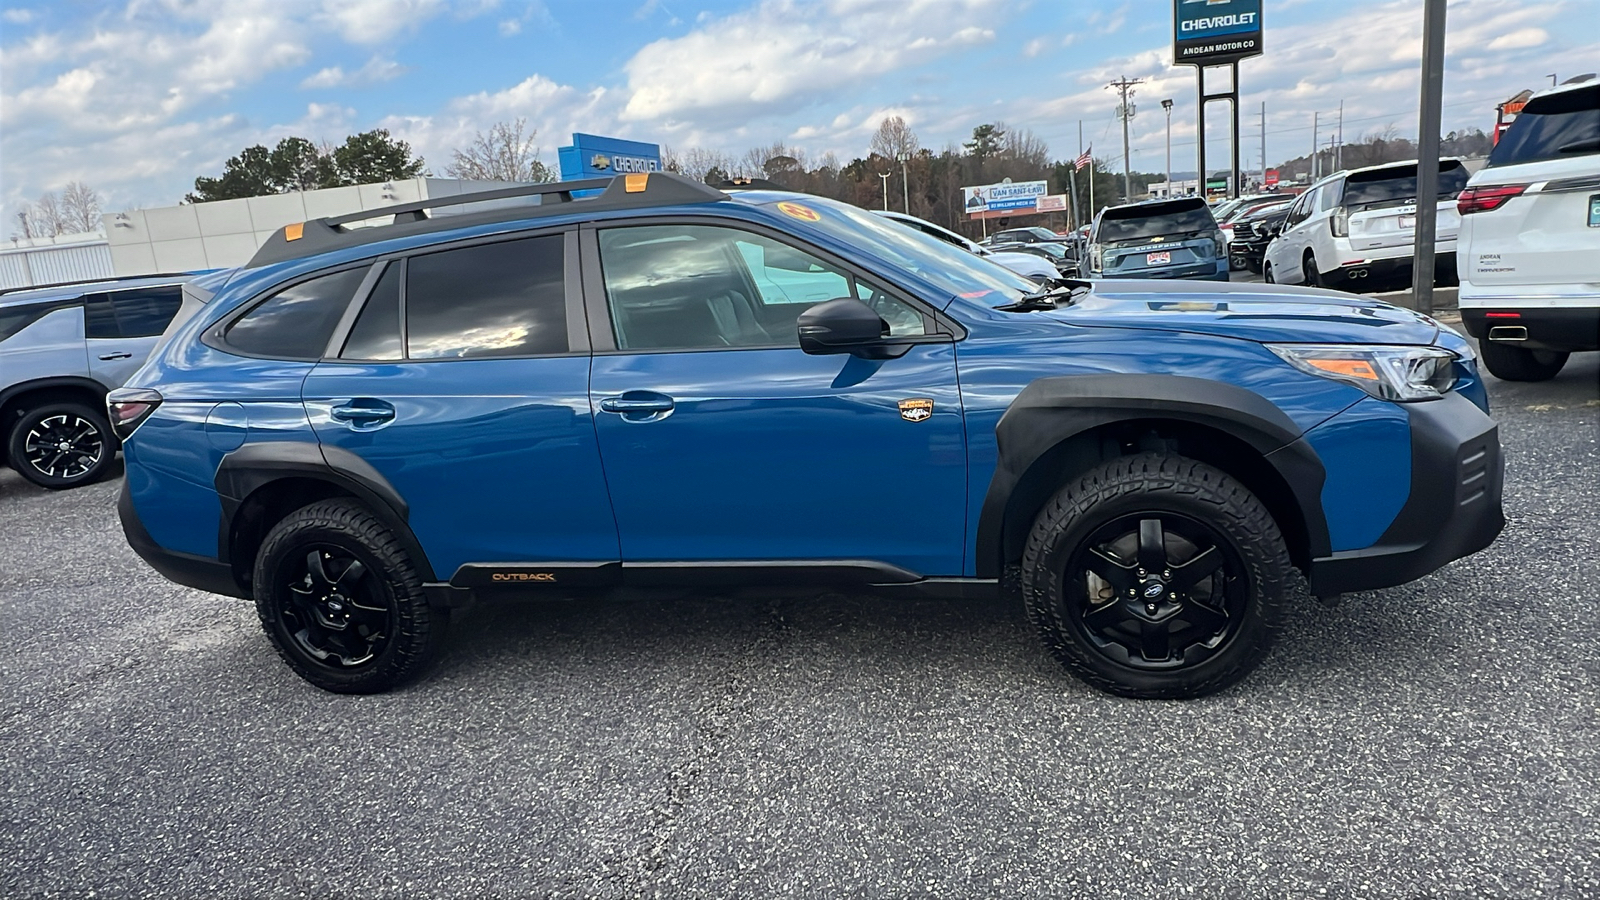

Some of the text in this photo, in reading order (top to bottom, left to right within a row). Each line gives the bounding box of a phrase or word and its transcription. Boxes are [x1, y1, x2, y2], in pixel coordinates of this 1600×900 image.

[1181, 12, 1256, 31] CHEVROLET
[1183, 40, 1254, 55] ANDEAN MOTOR CO
[613, 155, 658, 173] CHEVROLET
[992, 189, 1007, 197] VAN
